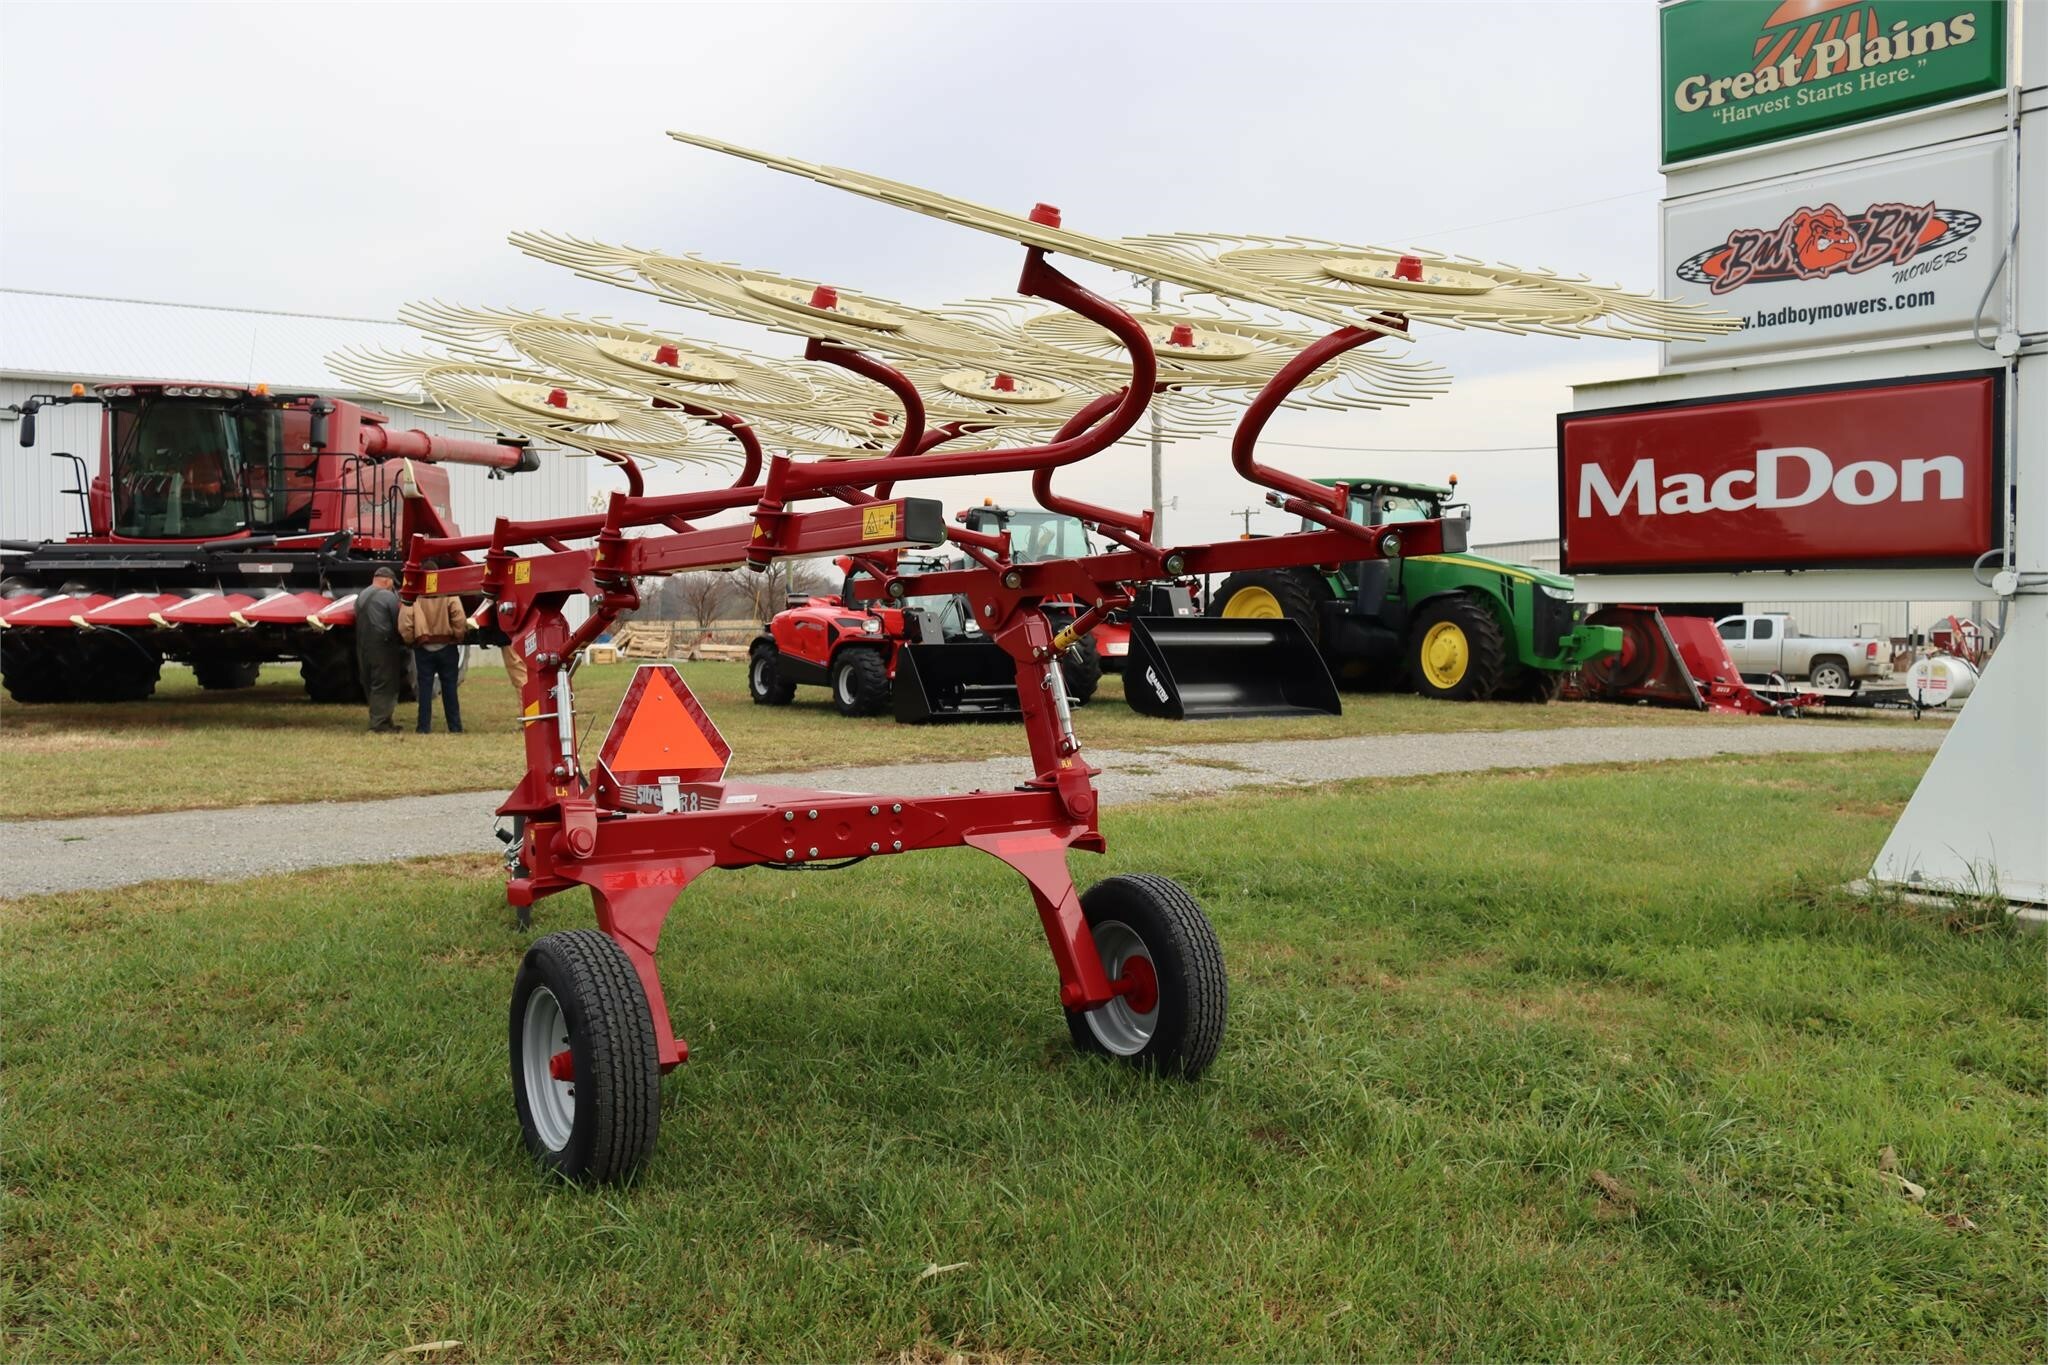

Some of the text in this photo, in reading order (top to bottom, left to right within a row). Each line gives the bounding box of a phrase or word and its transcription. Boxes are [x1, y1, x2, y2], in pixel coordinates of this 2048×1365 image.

[1675, 13, 1976, 112] Great Plains
[1713, 95, 1791, 124] “Harvest
[1796, 81, 1853, 106] Starts
[1713, 205, 1932, 292] Bad Boy
[1893, 247, 1968, 284] MOWERS
[1713, 290, 1935, 330] w.badboymowers.com
[1577, 446, 1964, 518] MacDon
